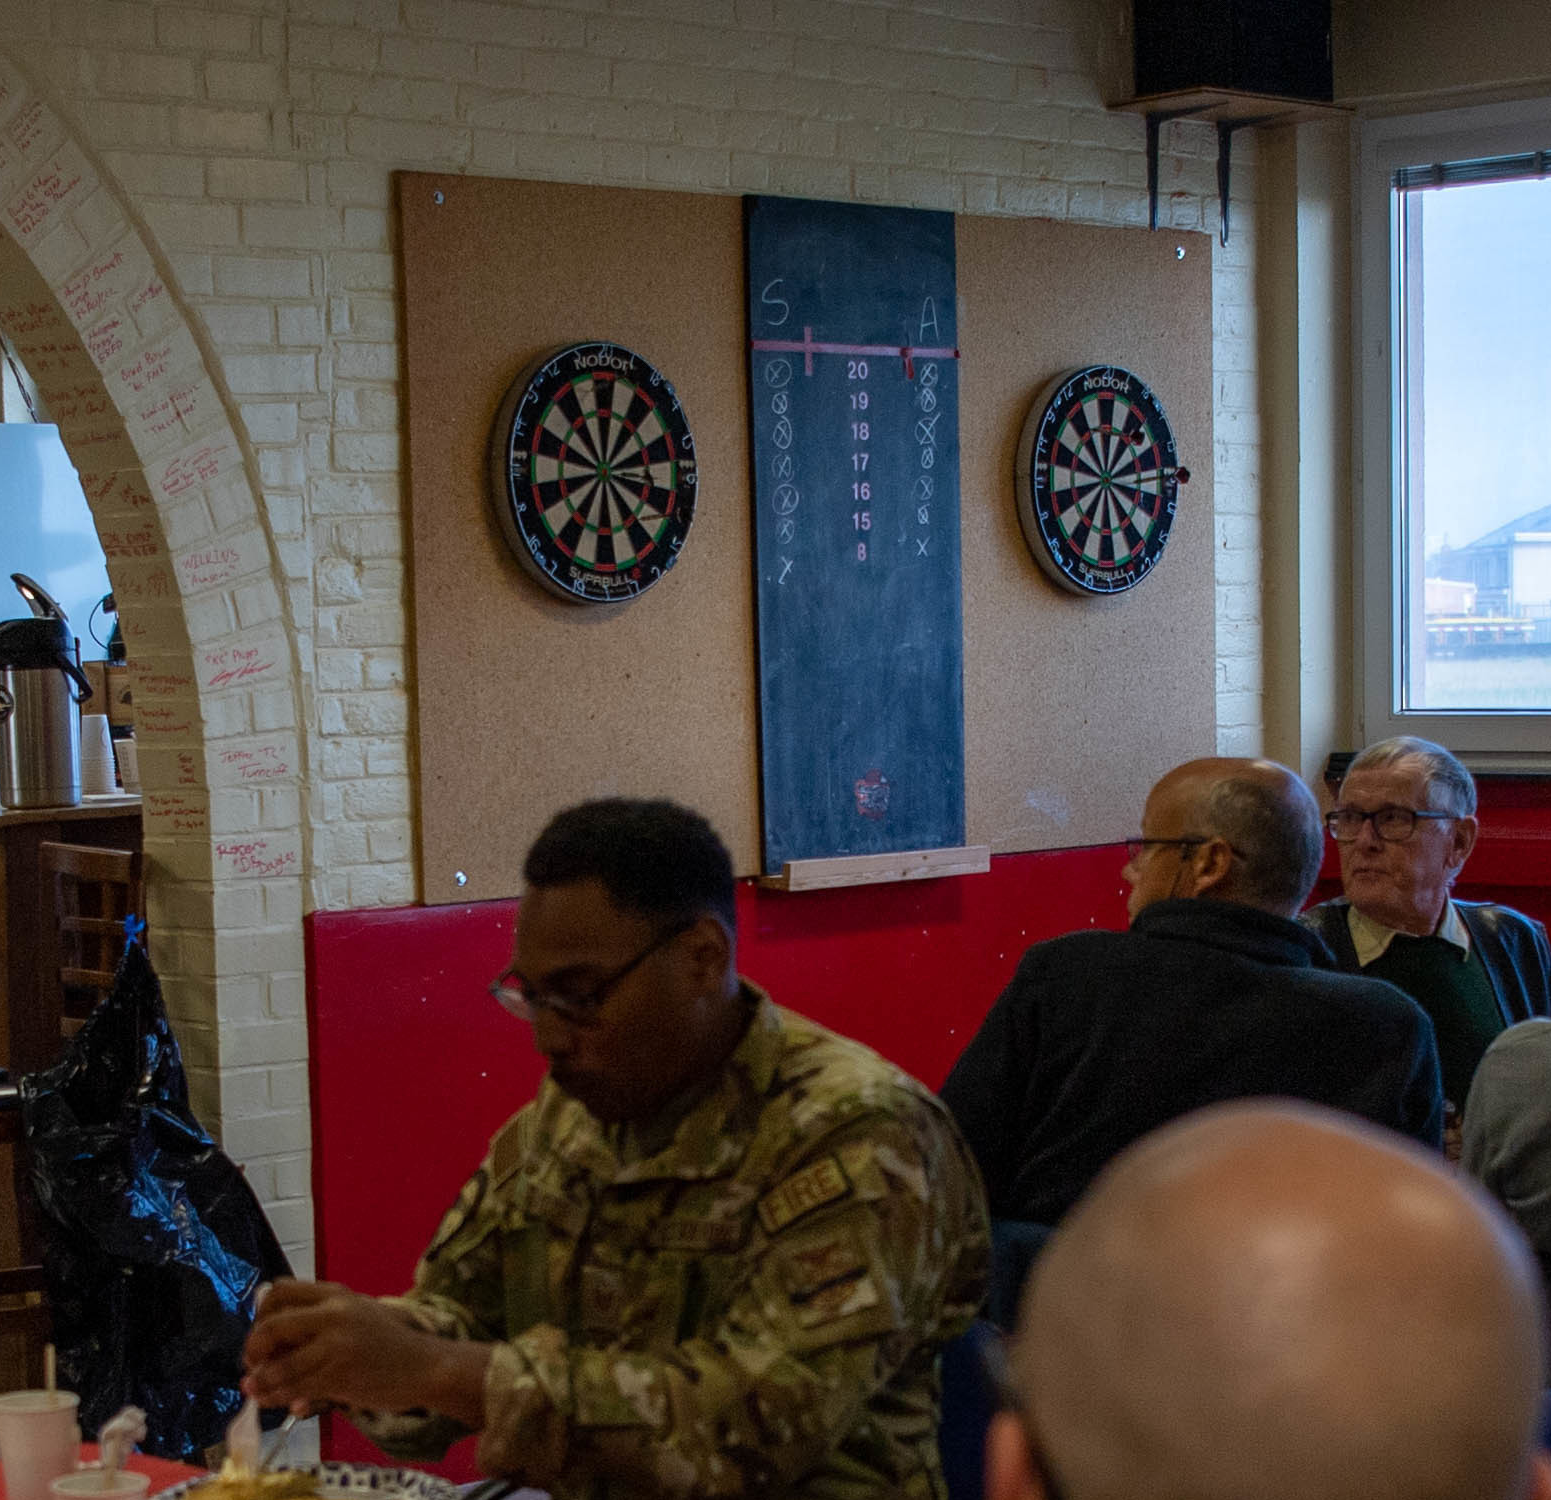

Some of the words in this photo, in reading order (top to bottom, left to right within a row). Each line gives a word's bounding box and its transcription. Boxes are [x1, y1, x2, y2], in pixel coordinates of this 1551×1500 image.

[762, 278, 789, 326] S
[919, 295, 940, 343] A
[847, 360, 868, 380] 20
[1083, 375, 1130, 395] NODOR
[850, 391, 869, 411] 19
[851, 421, 870, 441] 18
[851, 452, 869, 471] 17
[852, 481, 871, 501] 16
[852, 511, 871, 531] 15
[856, 542, 867, 561] 8
[767, 1165, 836, 1227] FIRE
